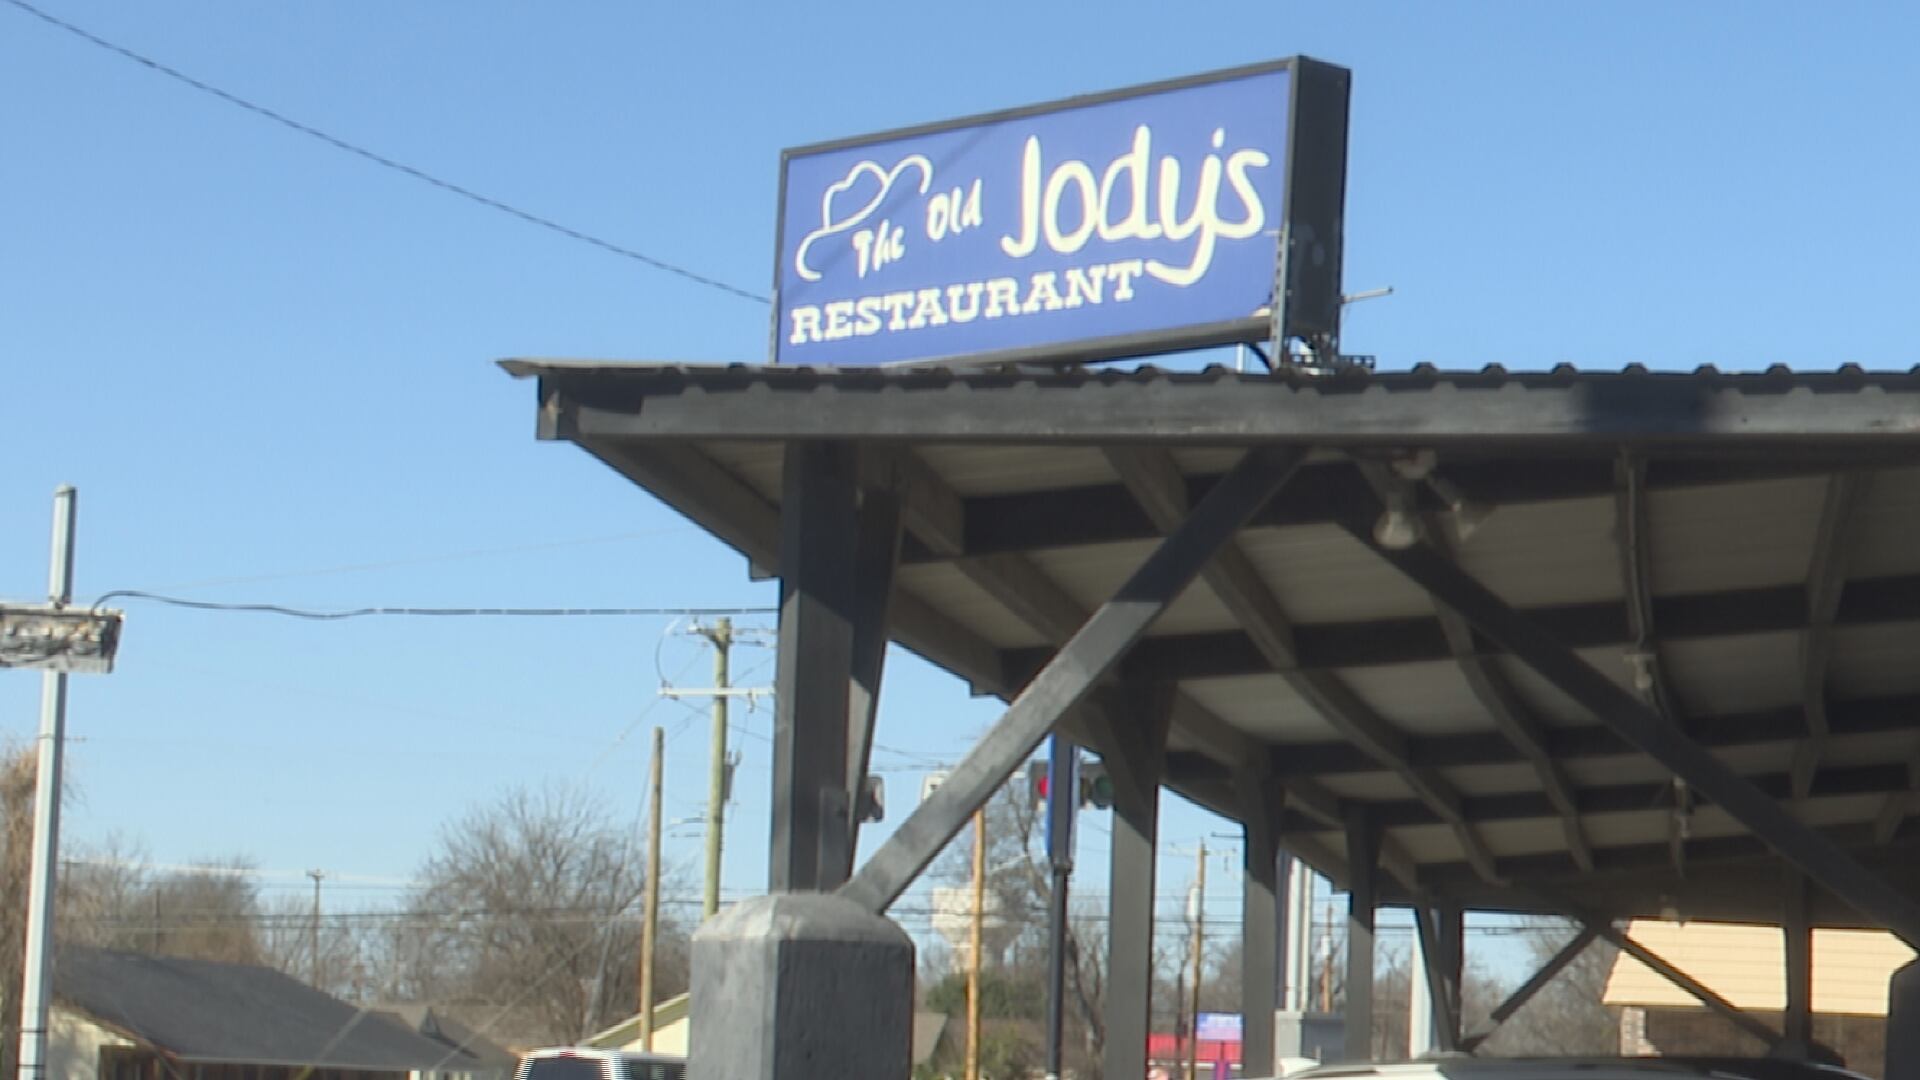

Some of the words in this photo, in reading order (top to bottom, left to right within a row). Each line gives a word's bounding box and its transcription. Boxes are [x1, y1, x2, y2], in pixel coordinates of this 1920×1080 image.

[852, 220, 904, 278] The
[926, 179, 982, 241] Old
[1000, 124, 1269, 287] Jody's
[790, 259, 1143, 344] RESTAURANT
